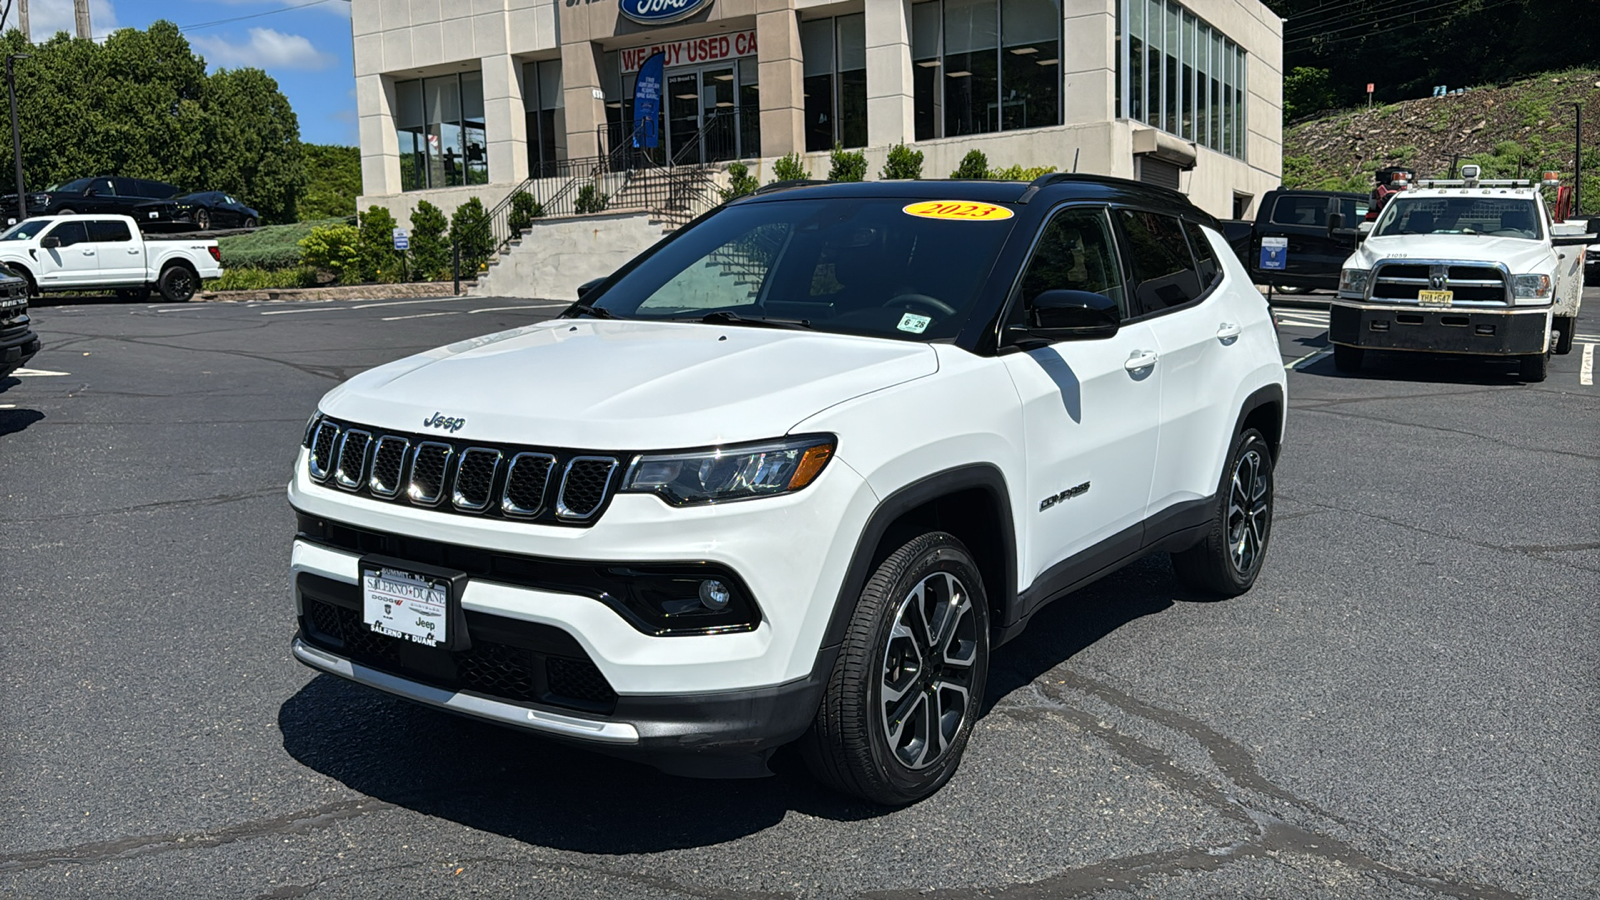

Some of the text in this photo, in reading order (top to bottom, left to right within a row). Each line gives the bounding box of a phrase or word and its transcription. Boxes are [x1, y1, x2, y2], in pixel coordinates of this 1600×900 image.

[622, 48, 646, 70] WE
[687, 36, 730, 62] USED
[917, 204, 997, 217] 2023
[904, 318, 911, 326] 6
[423, 411, 466, 433] Jeep
[367, 578, 445, 604] SALERNO DUANE
[415, 617, 435, 631] Jeep
[370, 624, 437, 647] SALERNO DUANE
